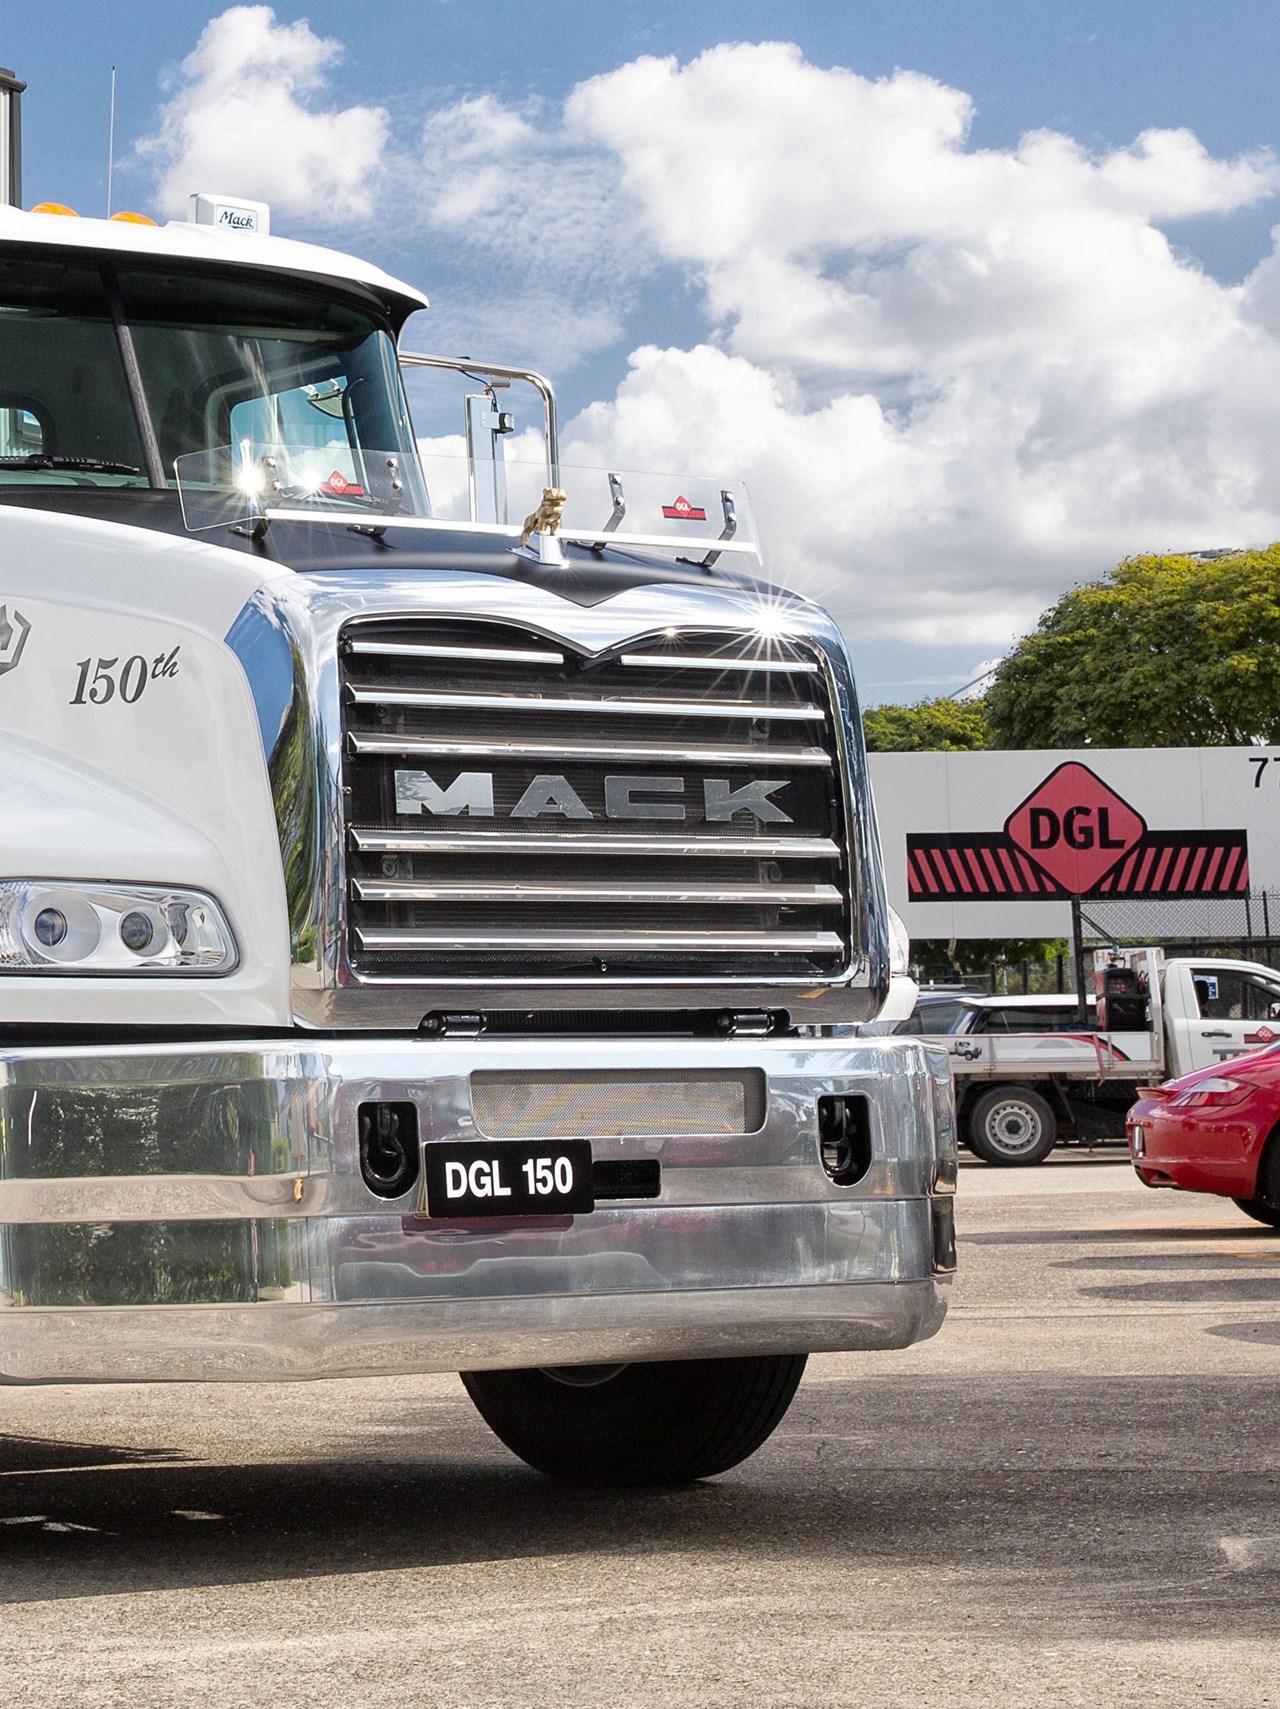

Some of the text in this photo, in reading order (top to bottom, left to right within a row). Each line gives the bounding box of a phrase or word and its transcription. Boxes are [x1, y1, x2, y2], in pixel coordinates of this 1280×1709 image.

[219, 211, 255, 229] Mack
[330, 478, 346, 487] DGL
[676, 502, 690, 512] DGL
[394, 769, 794, 823] MACK
[1029, 805, 1126, 850] DGL
[445, 1156, 574, 1199] DGL 150
